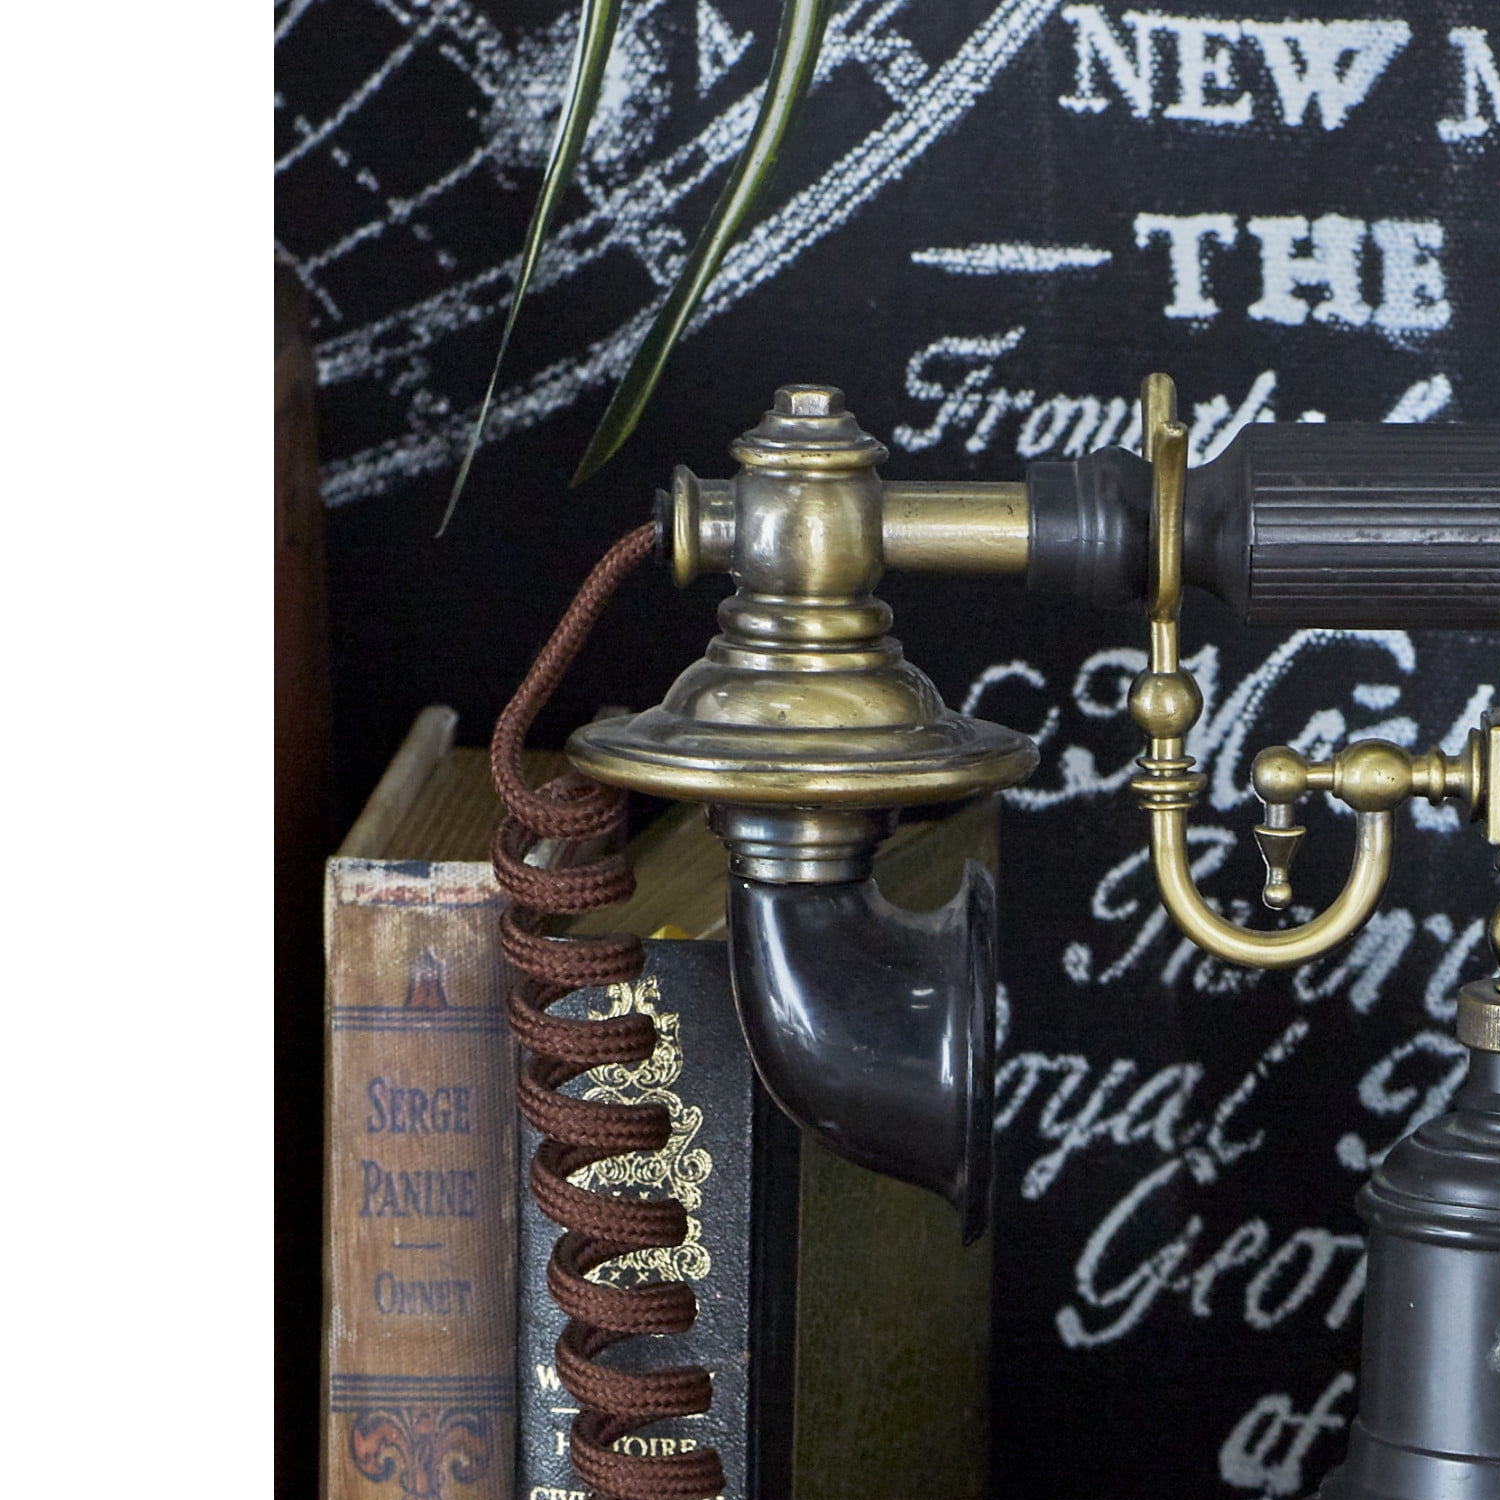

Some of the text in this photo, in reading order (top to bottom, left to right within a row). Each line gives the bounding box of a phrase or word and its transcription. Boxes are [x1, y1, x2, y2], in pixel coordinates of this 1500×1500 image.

[1058, 5, 1411, 131] NEW
[1132, 212, 1452, 336] THE
[366, 1076, 472, 1134] SERGE
[358, 1159, 477, 1218] PANINE
[374, 1271, 472, 1315] OHNET
